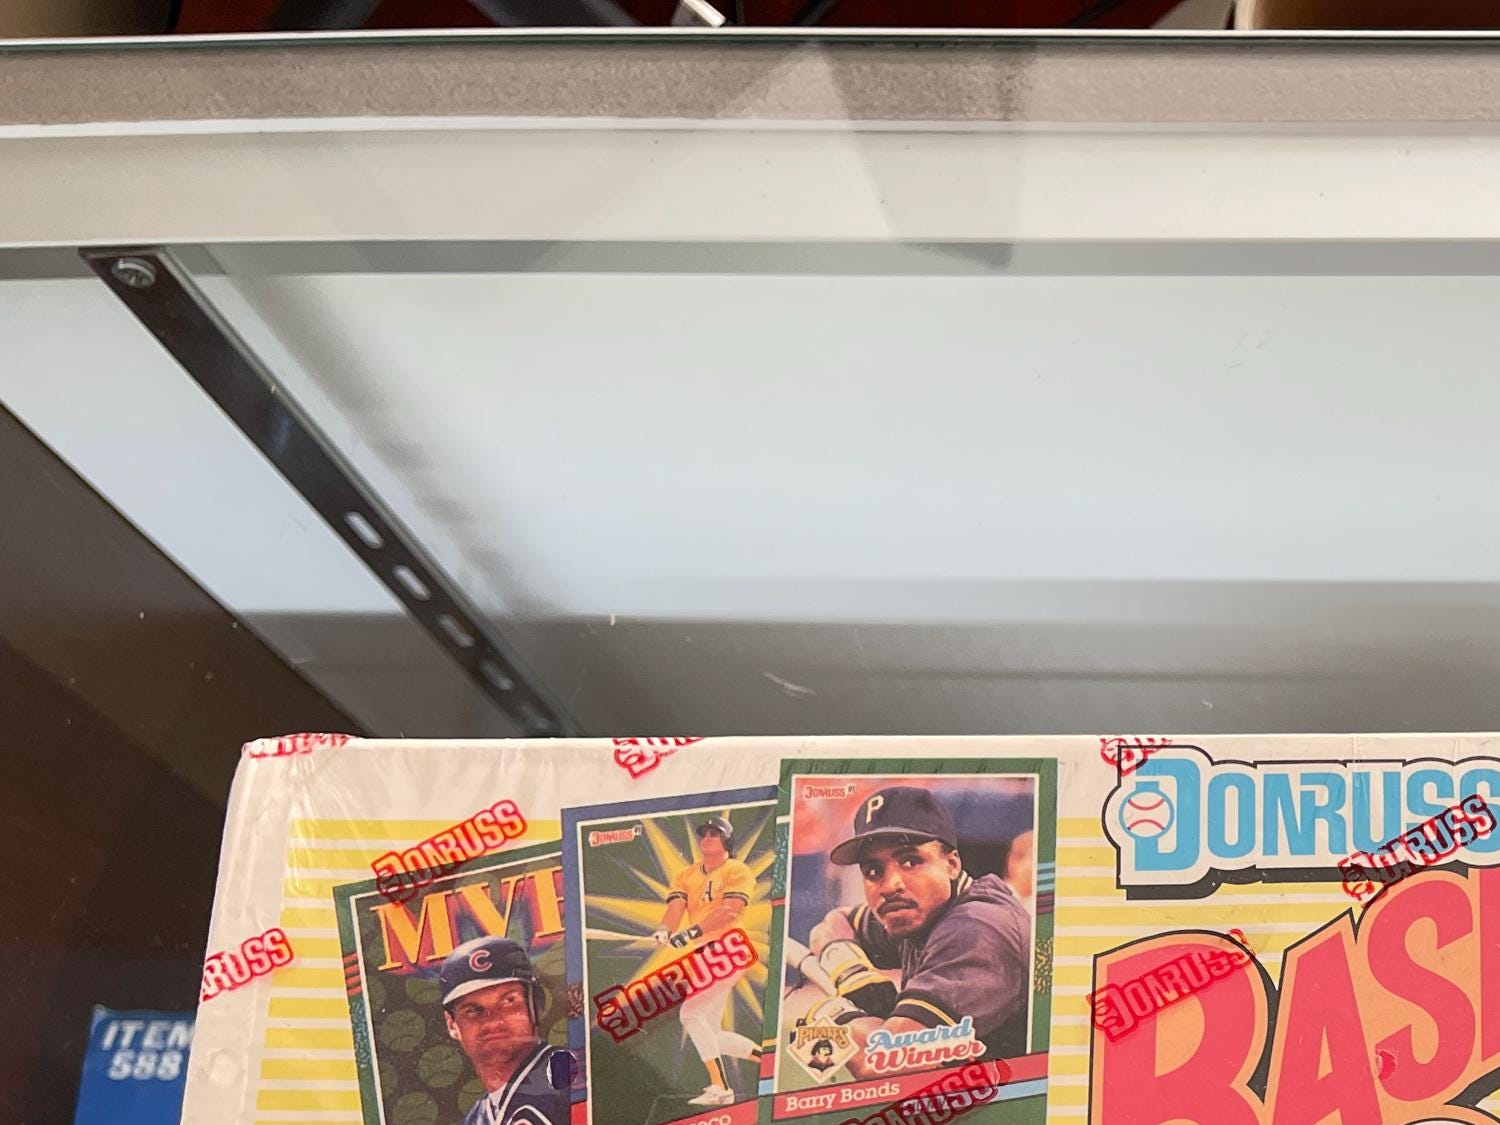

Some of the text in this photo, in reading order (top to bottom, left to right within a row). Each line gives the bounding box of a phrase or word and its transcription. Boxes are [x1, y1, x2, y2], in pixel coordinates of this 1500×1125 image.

[373, 800, 528, 906] DONRUSS
[594, 927, 757, 1041] DONRUSS
[1086, 929, 1256, 1043] DONRUSS
[868, 1017, 972, 1051] Award
[107, 1050, 183, 1081] 588
[866, 1041, 986, 1073] Winner
[785, 1088, 836, 1112] Barry
[840, 1082, 900, 1105] Bonds
